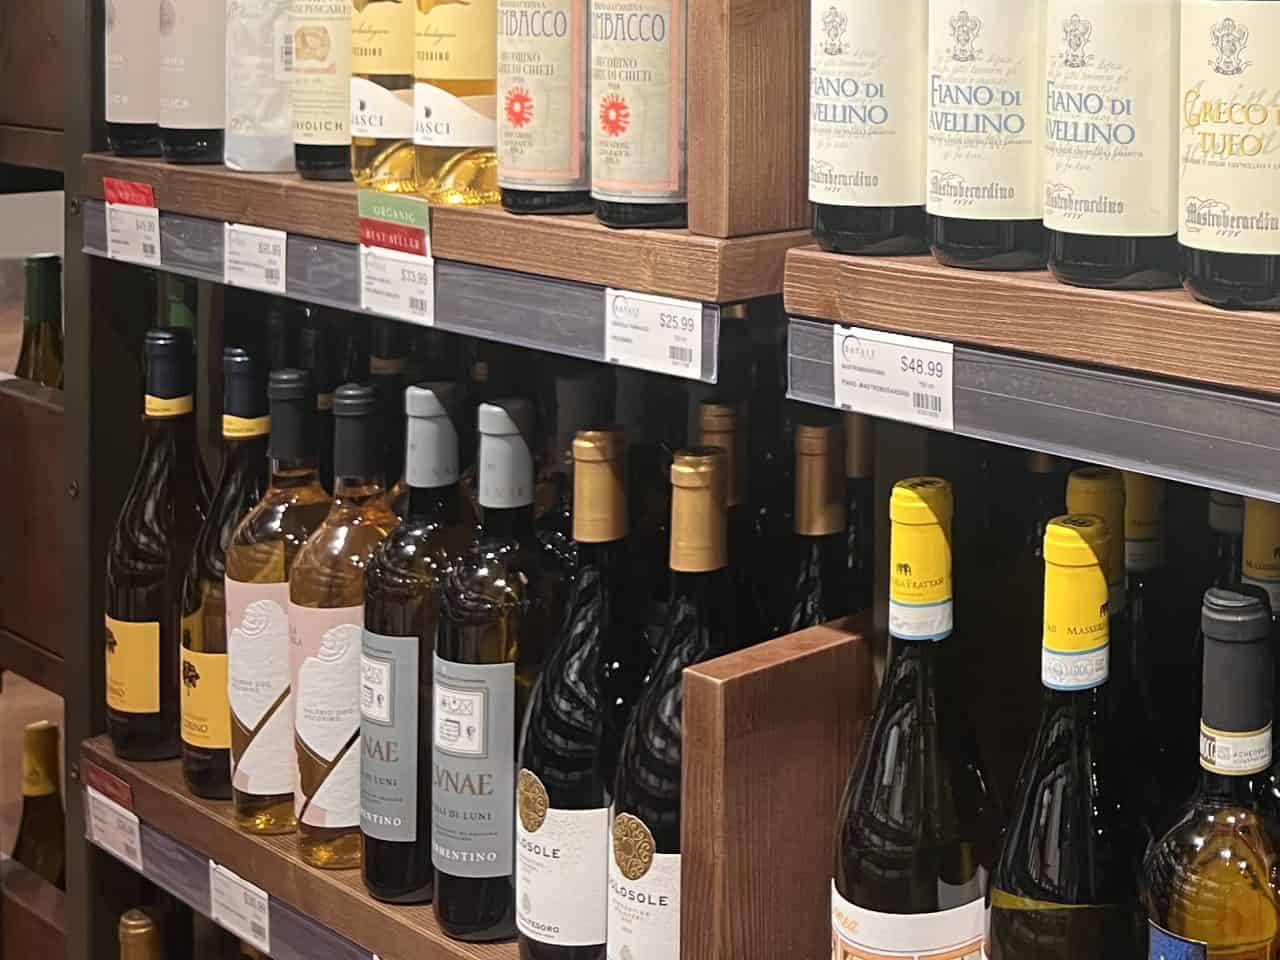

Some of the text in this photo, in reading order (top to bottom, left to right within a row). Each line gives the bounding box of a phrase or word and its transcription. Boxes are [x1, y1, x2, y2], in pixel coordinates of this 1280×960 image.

[865, 82, 886, 98] DI
[931, 74, 1022, 108] FIANO DI
[1111, 98, 1132, 116] DI
[1183, 88, 1269, 128] GRECO
[929, 110, 1026, 135] AVELLINO
[1197, 130, 1263, 157] TUFO
[373, 206, 416, 223] ORGANIC
[659, 313, 694, 332] $25.99
[900, 355, 944, 379] $48.99
[463, 811, 492, 821] LUNI
